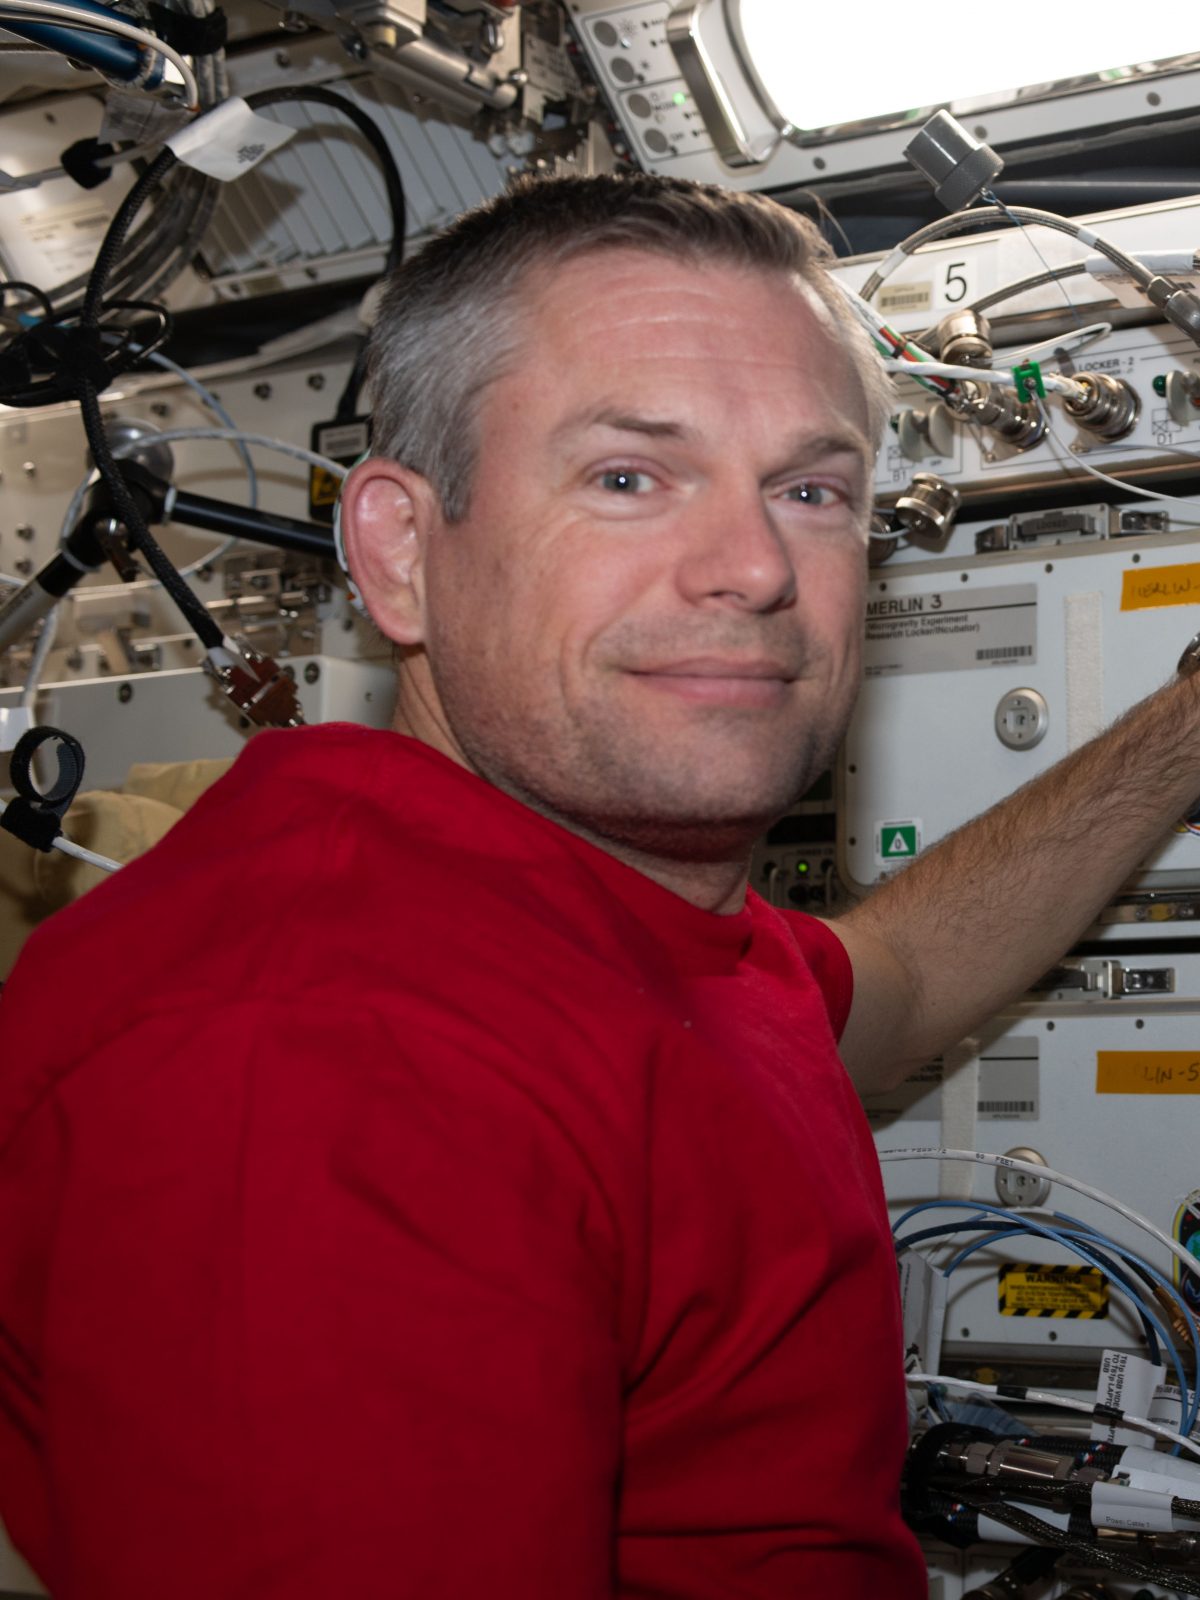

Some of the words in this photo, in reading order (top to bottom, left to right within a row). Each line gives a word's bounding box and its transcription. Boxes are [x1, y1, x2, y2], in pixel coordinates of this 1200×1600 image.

[945, 262, 967, 302] 5
[1079, 359, 1120, 372] LOCKER
[1157, 433, 1173, 445] D1
[866, 597, 923, 615] MERLIN
[930, 594, 942, 609] 3
[1112, 1353, 1120, 1364] TO
[1117, 1372, 1125, 1386] USB
[1113, 1387, 1122, 1410] VIDE
